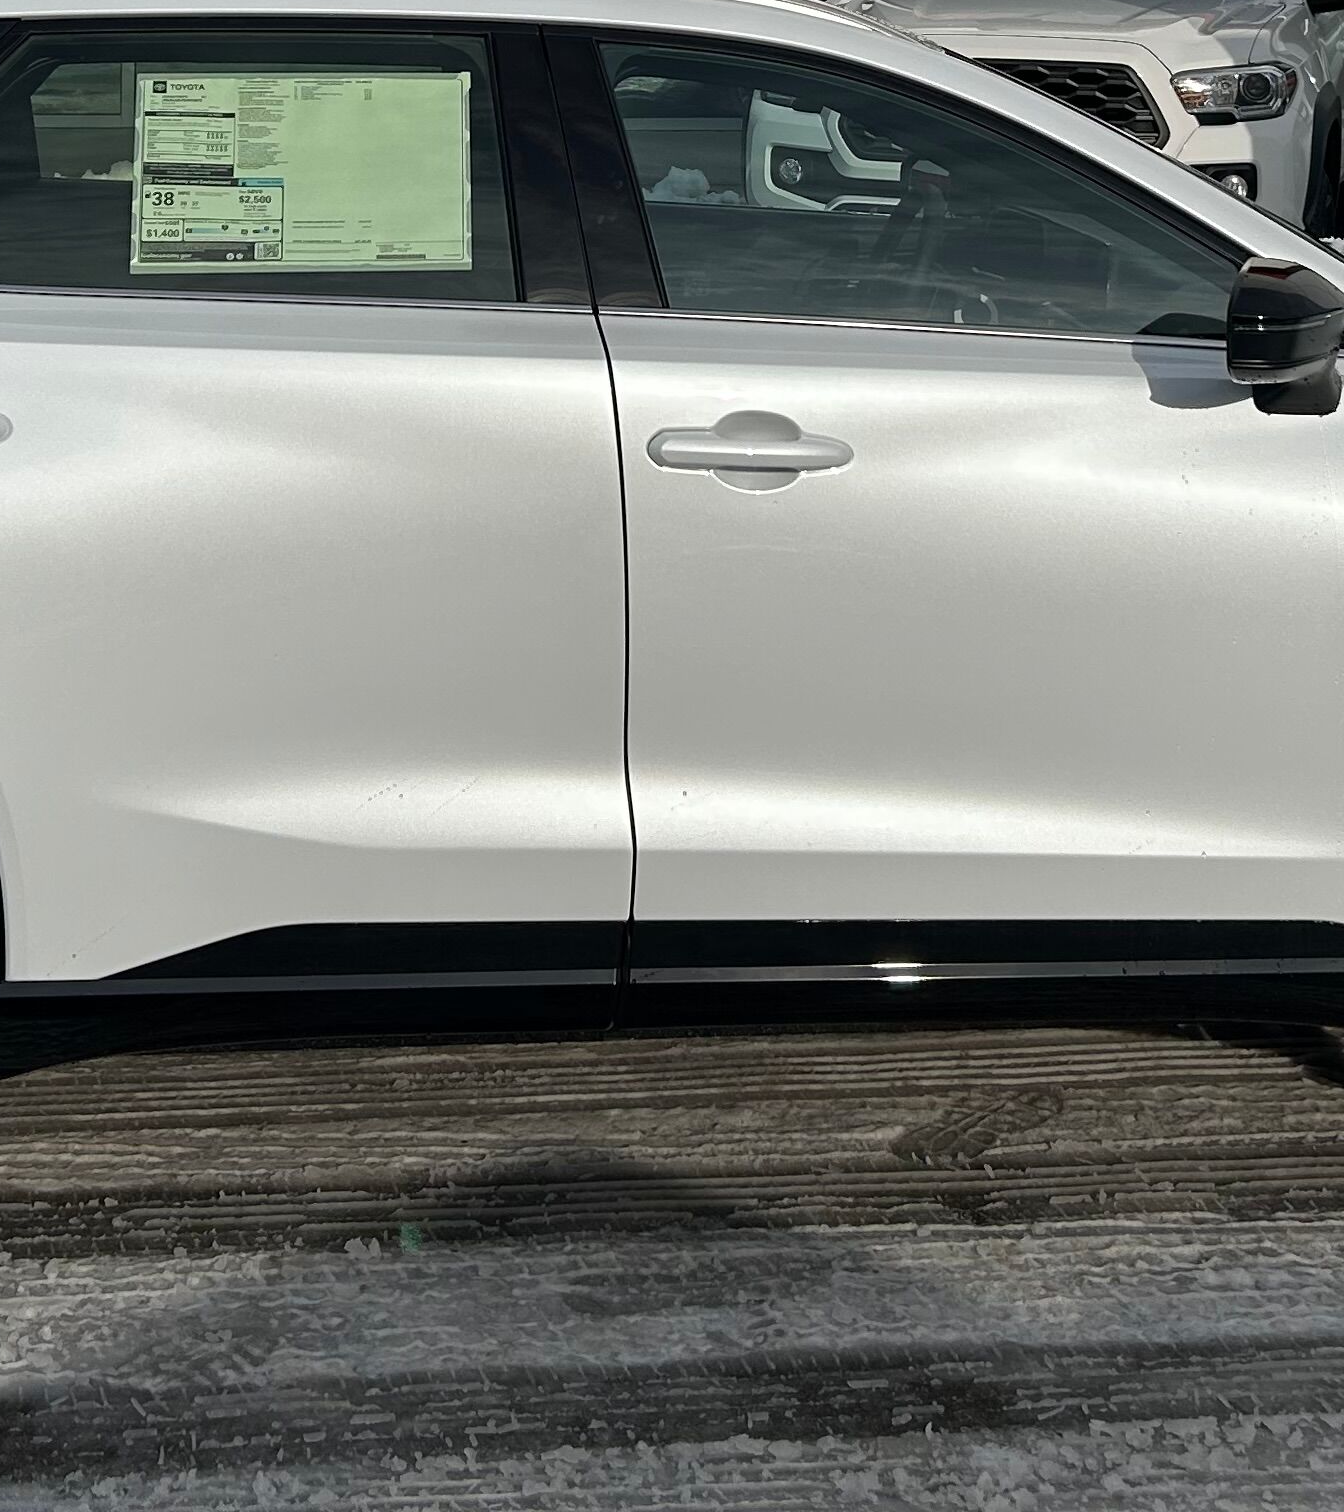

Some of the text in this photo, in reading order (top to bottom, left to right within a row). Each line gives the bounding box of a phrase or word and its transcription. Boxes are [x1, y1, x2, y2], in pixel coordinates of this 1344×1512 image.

[170, 83, 206, 91] TOYOTA
[151, 191, 175, 206] 38
[238, 195, 272, 204] $2,500
[145, 228, 180, 238] $1,400
